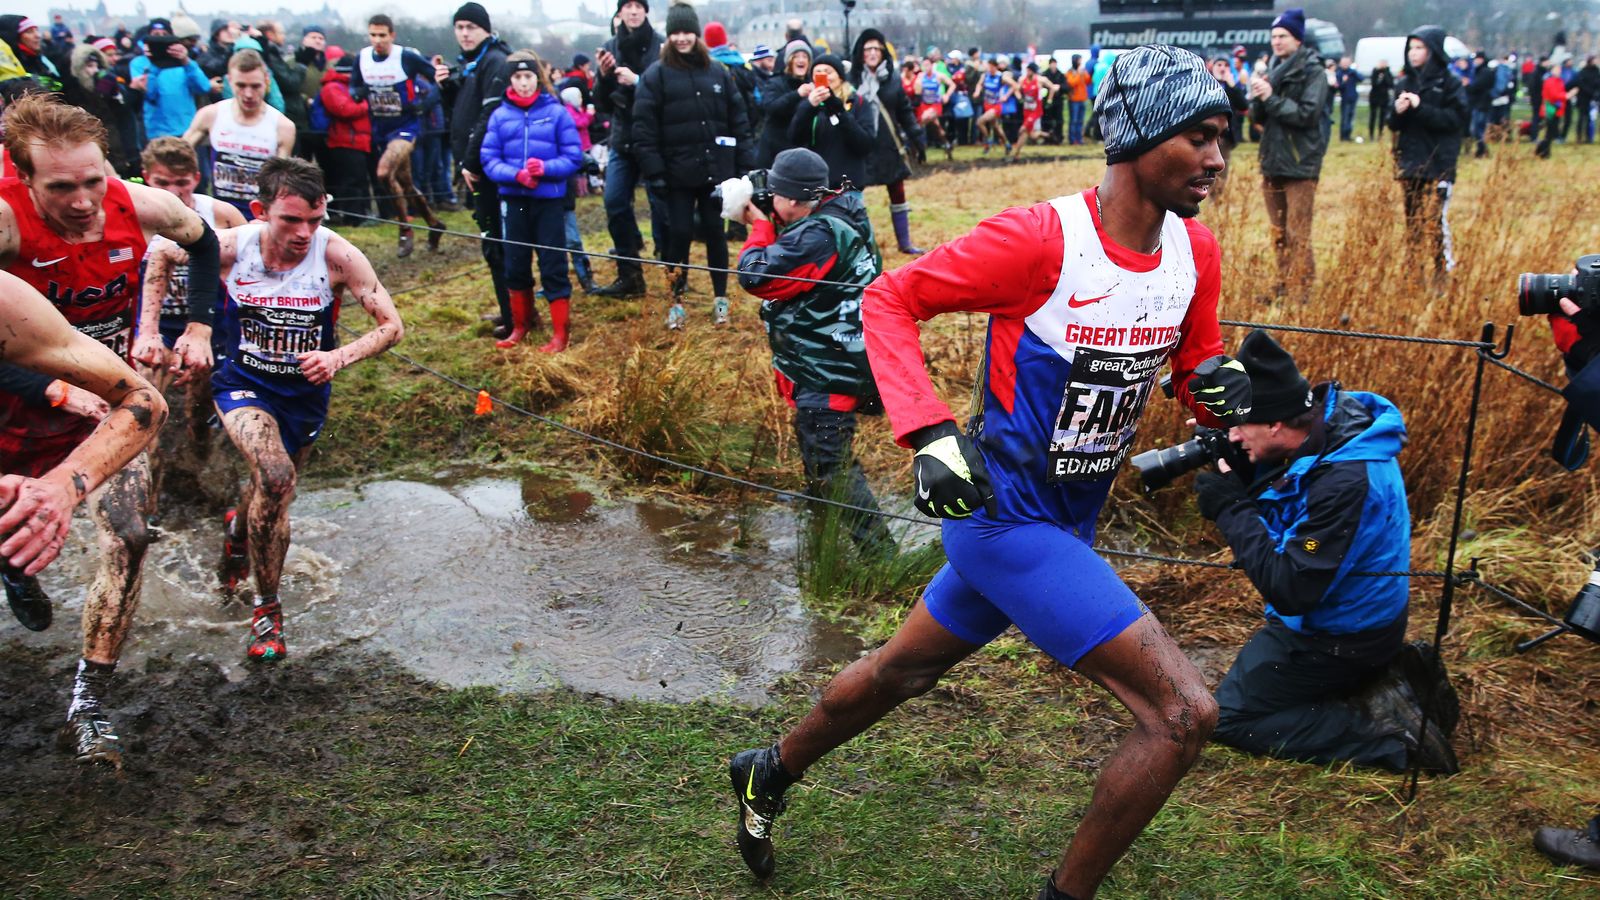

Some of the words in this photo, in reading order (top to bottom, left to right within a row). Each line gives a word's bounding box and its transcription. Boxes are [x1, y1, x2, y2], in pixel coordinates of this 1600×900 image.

[1093, 28, 1270, 48] theadigroup.com
[47, 272, 127, 308] USA
[237, 293, 274, 306] GREAT
[277, 296, 321, 307] BRITAIN
[242, 319, 319, 353] GRIFFITHS
[1065, 323, 1127, 346] GREAT
[242, 354, 304, 374] EDINBURG
[1090, 359, 1127, 373] great
[1134, 354, 1163, 371] edinb
[1058, 384, 1144, 434] FARA
